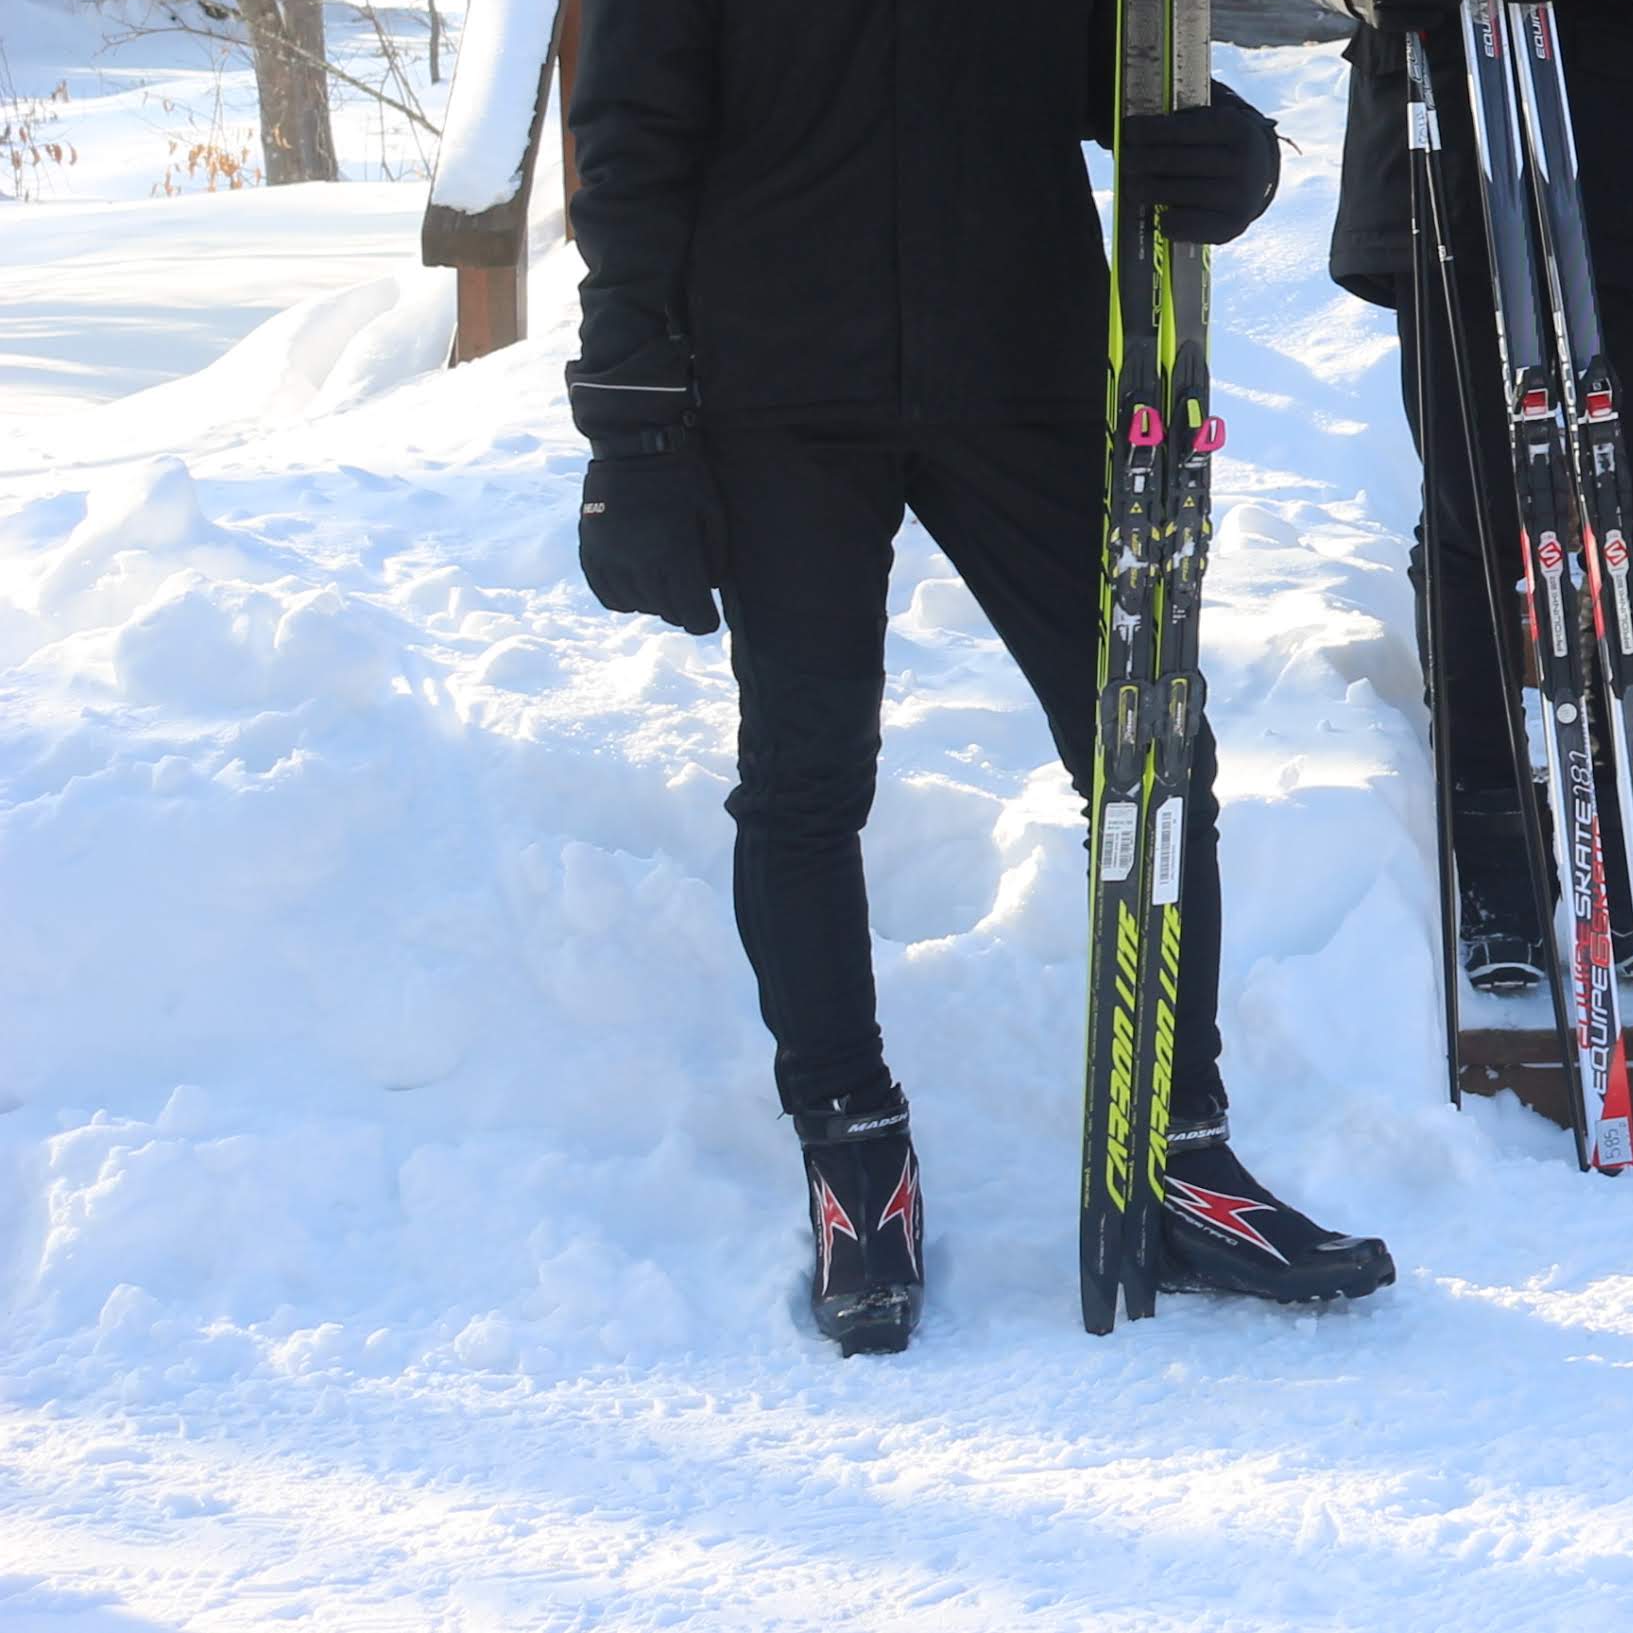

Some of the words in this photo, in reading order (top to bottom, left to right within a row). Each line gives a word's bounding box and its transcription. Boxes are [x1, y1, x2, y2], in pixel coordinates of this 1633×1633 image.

[1569, 750, 1591, 797] 181
[1574, 799, 1593, 920] SKATE
[1115, 900, 1138, 1011] LITE
[1159, 904, 1182, 1004] LITE
[1106, 1008, 1133, 1213] CARBON
[1604, 1127, 1623, 1161] 585
